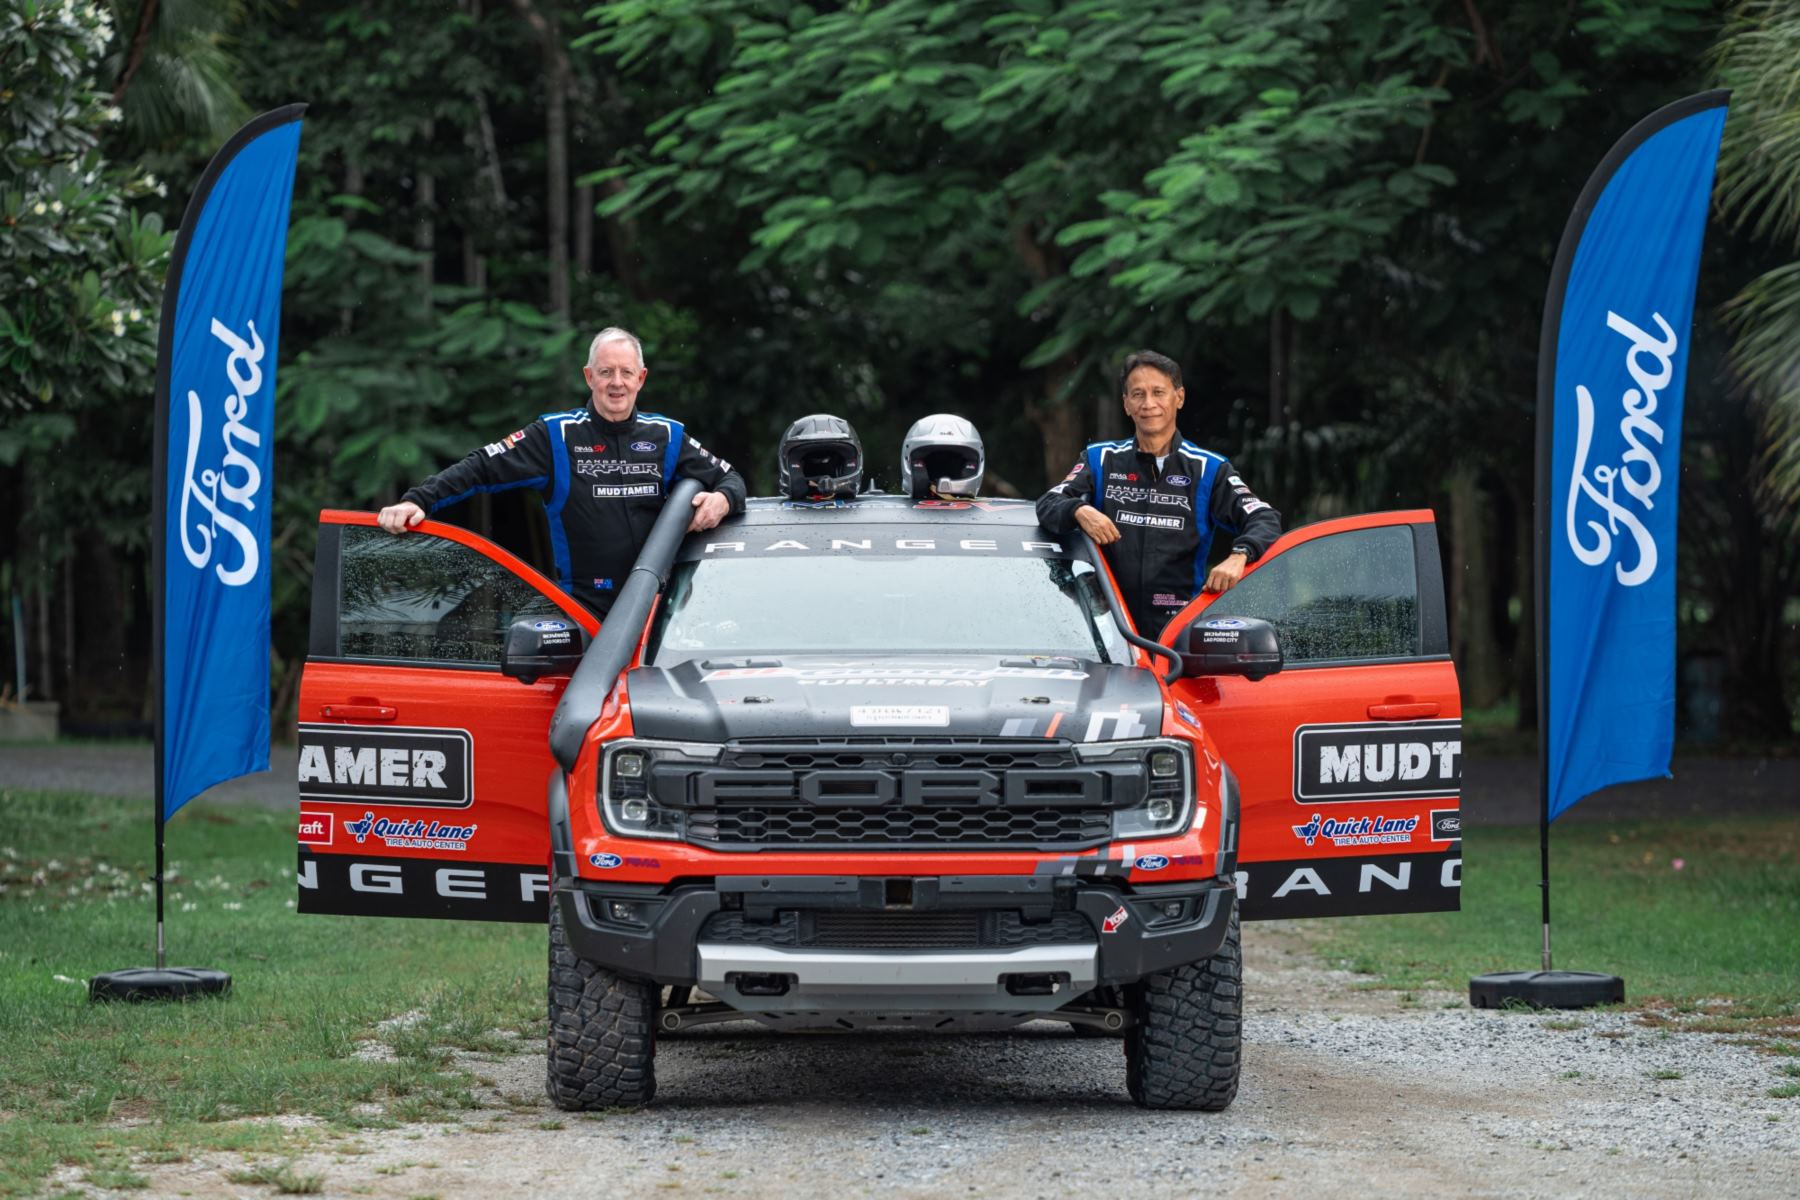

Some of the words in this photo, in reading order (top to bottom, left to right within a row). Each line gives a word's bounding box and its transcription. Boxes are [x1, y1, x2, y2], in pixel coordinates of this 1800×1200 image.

[181, 319, 264, 585] Ford
[1568, 312, 1676, 585] Ford
[577, 463, 662, 478] RAPTOR
[597, 485, 655, 496] MUDTAMER
[1105, 488, 1192, 511] RAPTOR
[1120, 513, 1181, 528] MUDTAMER
[704, 539, 1063, 553] RANGER
[1319, 741, 1461, 784] MUDT
[700, 770, 1103, 807] FORD
[373, 818, 423, 838] Quick
[426, 821, 474, 840] Lane
[1321, 818, 1368, 837] Quick
[1371, 817, 1417, 833] Lane
[386, 838, 404, 847] TIRE
[410, 840, 433, 848] AUTO
[434, 841, 466, 850] CENTER
[1334, 837, 1352, 846] TIRE
[1358, 836, 1380, 845] AUTO
[1381, 834, 1411, 843] CENTER
[594, 853, 616, 867] Ford
[1140, 855, 1163, 869] Ford
[1235, 858, 1461, 899] AN
